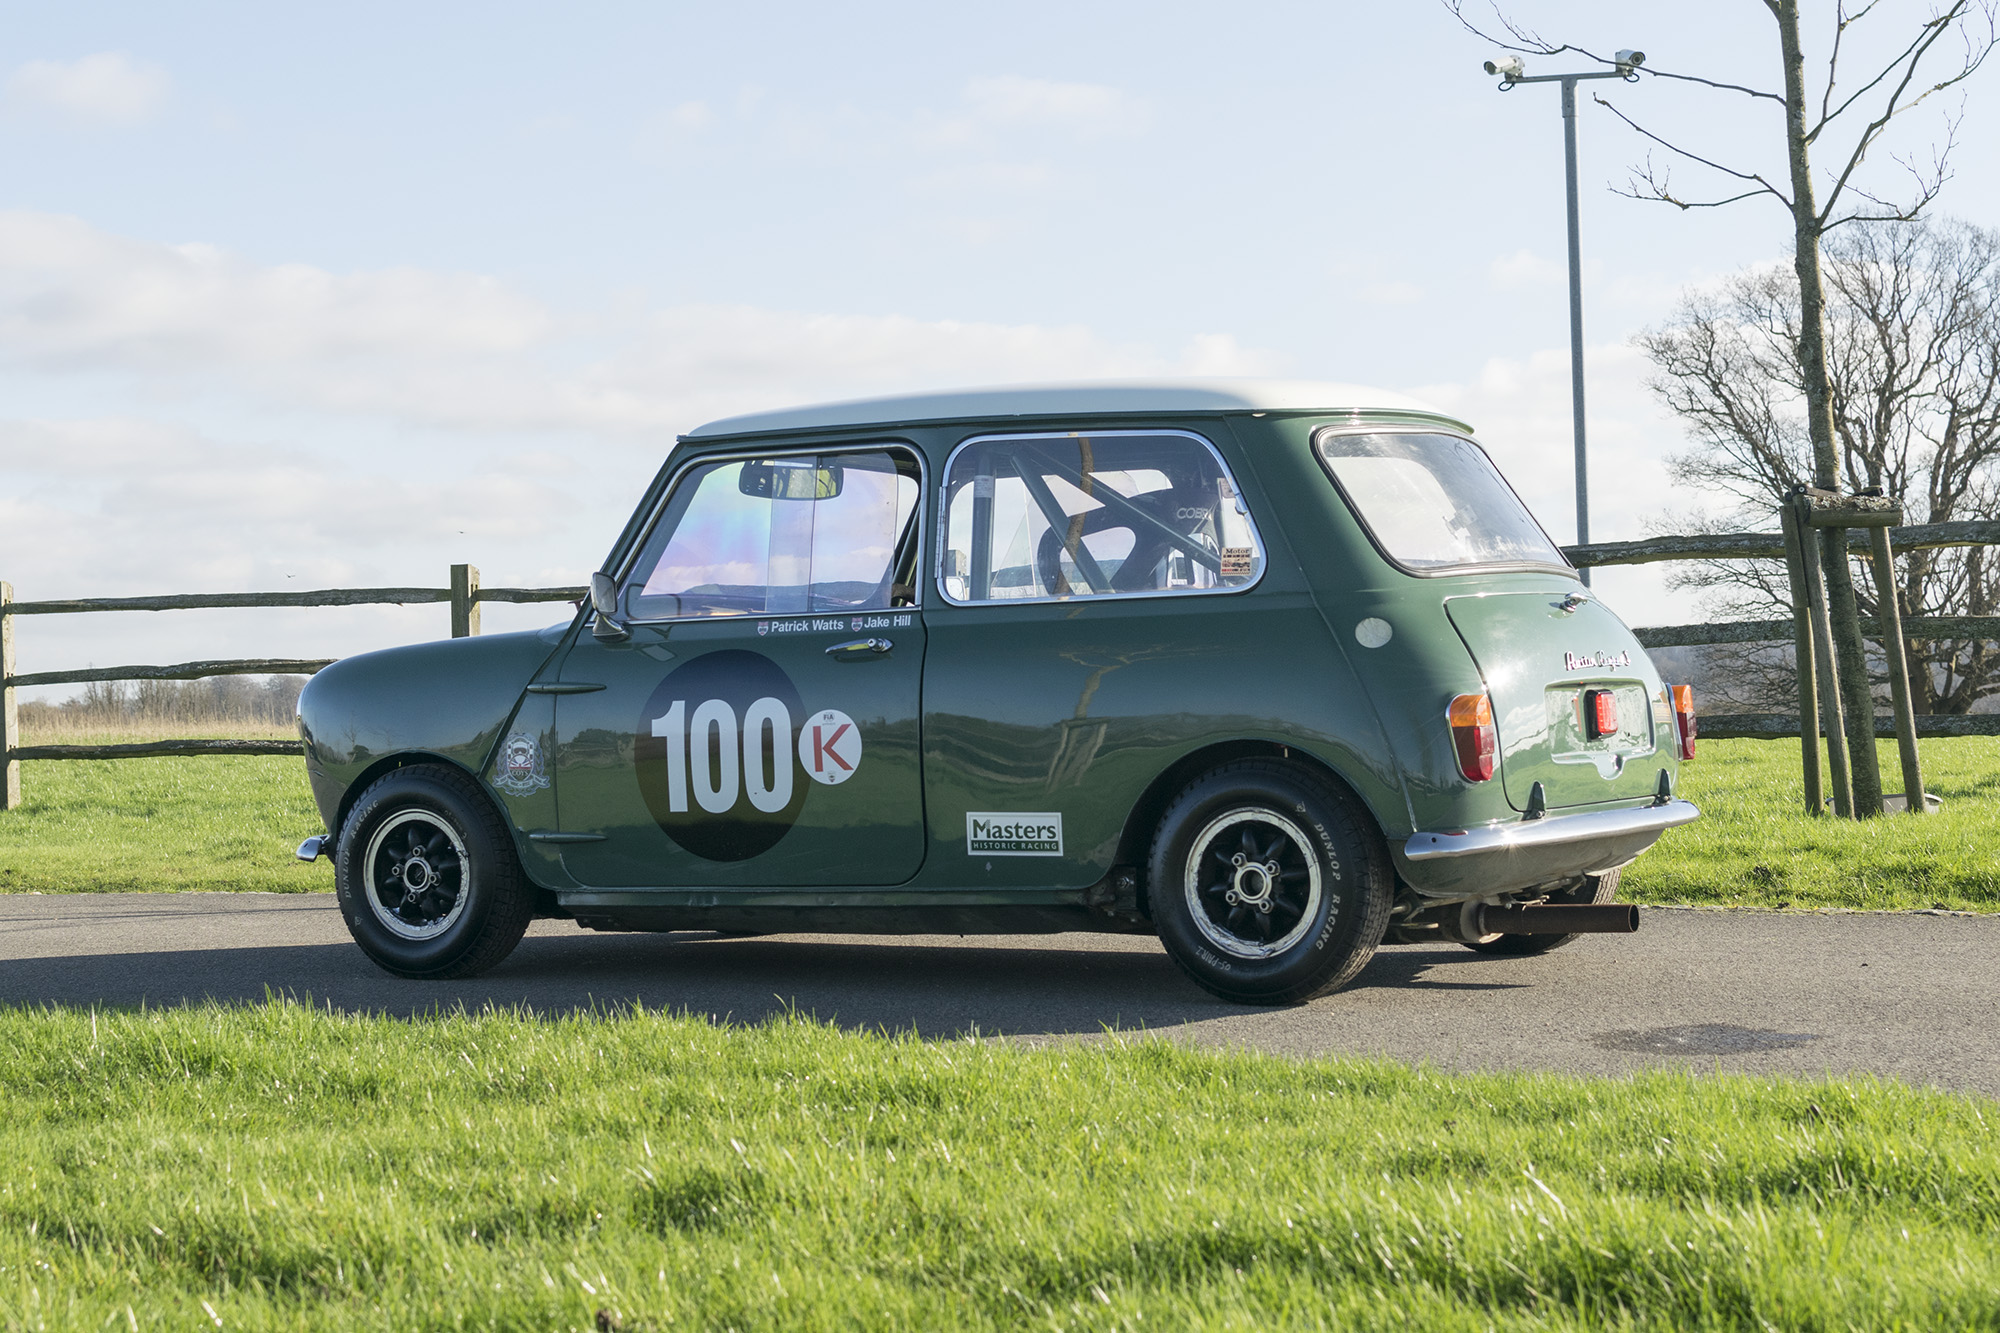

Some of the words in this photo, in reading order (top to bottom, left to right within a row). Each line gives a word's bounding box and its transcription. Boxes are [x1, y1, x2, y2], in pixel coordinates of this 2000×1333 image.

[771, 620, 809, 633] Patrick
[812, 619, 844, 631] Watts
[864, 616, 889, 628] Jake
[893, 614, 912, 627] Hill
[651, 696, 794, 814] 100
[812, 723, 854, 773] K
[342, 847, 352, 899] DUNLOP
[350, 799, 379, 839] RACING
[972, 818, 1057, 839] Masters
[1021, 842, 1057, 850] RACING
[1313, 823, 1341, 881] DUNLOP
[1315, 893, 1341, 950] RACING
